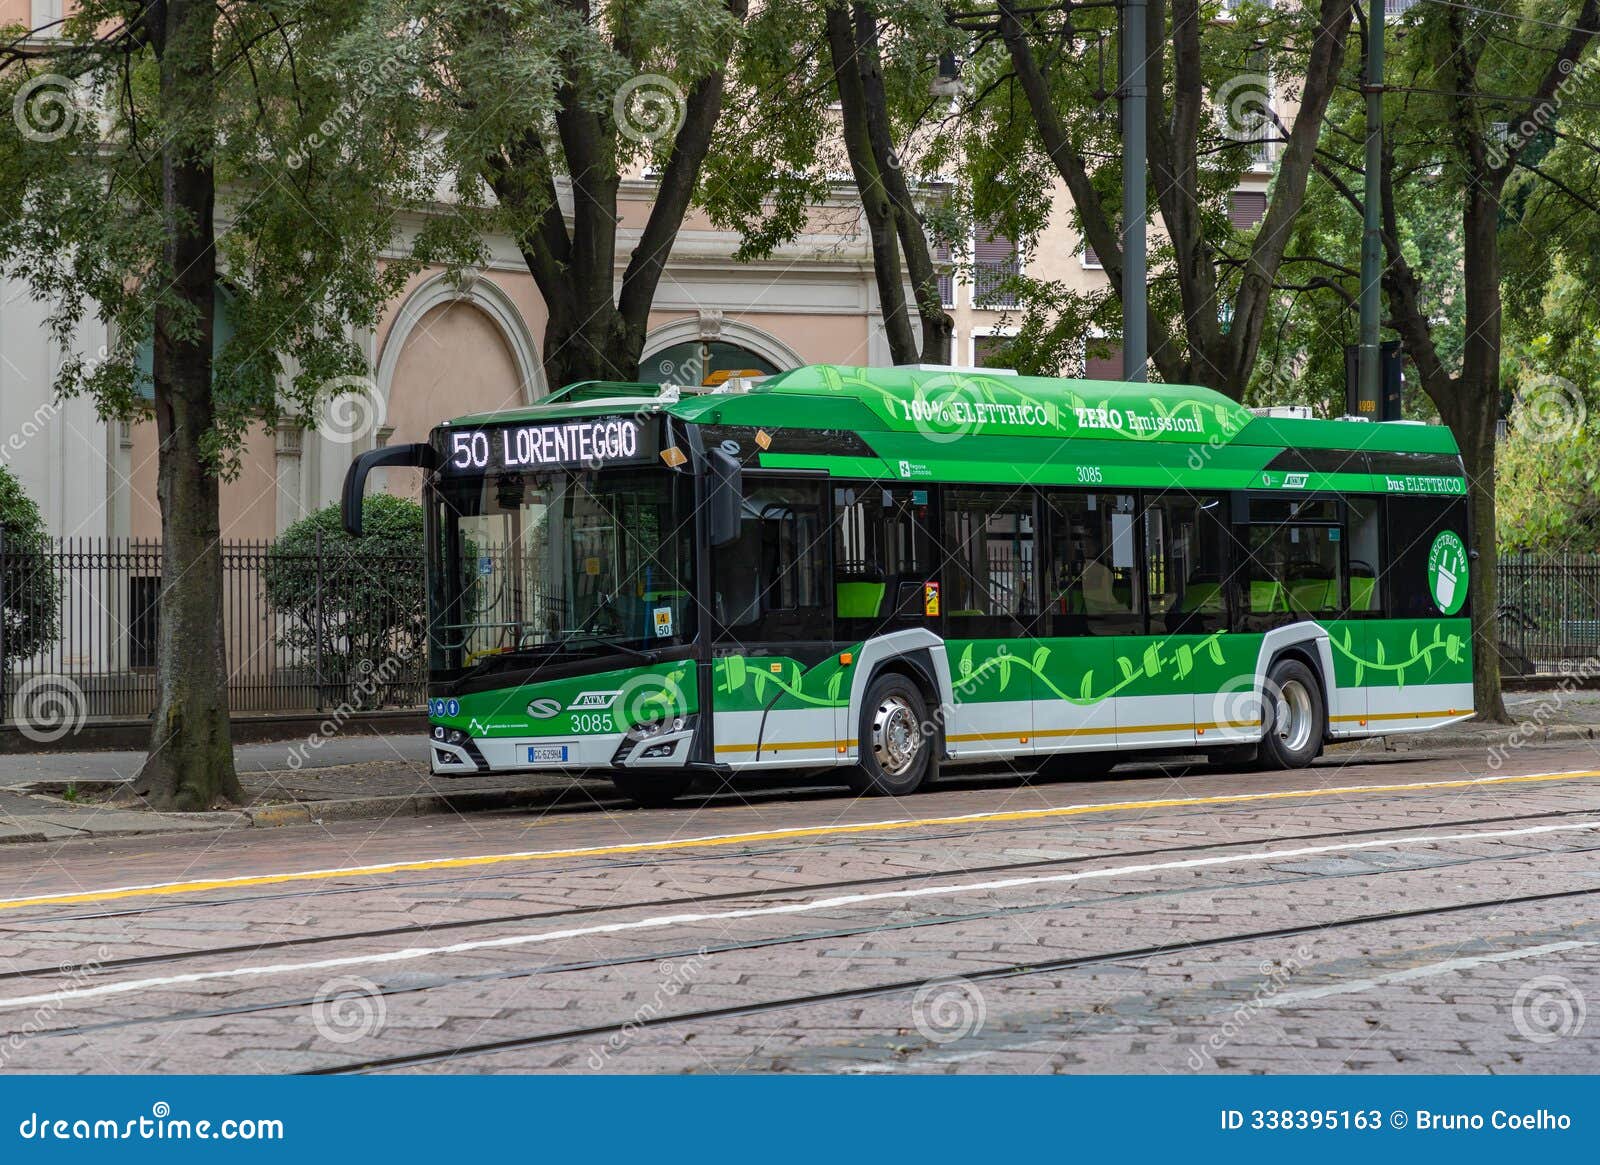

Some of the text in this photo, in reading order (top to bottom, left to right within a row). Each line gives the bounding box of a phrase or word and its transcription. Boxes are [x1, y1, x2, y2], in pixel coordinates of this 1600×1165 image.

[903, 399, 1204, 433] 100% ELETTRICO ZERO Emissioni
[453, 421, 636, 468] 50 LORENTEGGIO
[1076, 466, 1102, 483] 3085
[1386, 477, 1461, 492] bus ELETTRICO
[1430, 535, 1465, 573] ELECTRIC bus
[658, 625, 670, 635] 50
[583, 695, 606, 705] ATM
[570, 714, 612, 732] 3085
